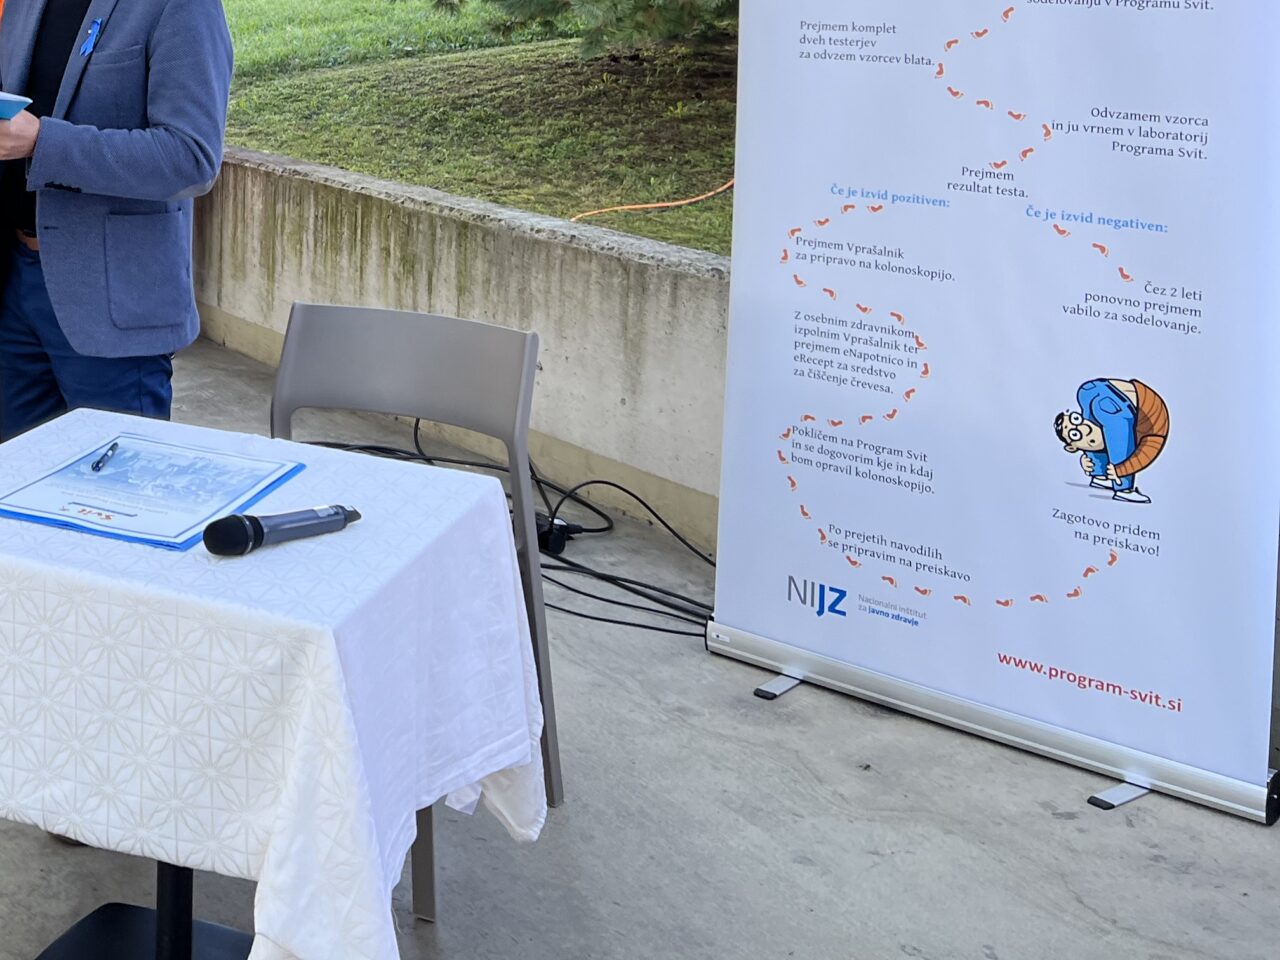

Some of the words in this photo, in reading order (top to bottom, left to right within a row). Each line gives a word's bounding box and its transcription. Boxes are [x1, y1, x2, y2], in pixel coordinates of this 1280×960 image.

[800, 21, 848, 33] Prejmem
[852, 22, 896, 35] komplet
[800, 35, 825, 45] dveh
[829, 37, 876, 49] testerjev
[799, 51, 810, 59] za
[814, 50, 855, 61] odvzem
[860, 55, 901, 63] vzorcev
[904, 54, 935, 65] blata.
[1091, 107, 1160, 123] Odvzamem
[1165, 115, 1208, 126] vzorca
[1052, 120, 1063, 130] in
[1066, 122, 1079, 134] ju
[1083, 124, 1123, 135] vrnem
[1128, 128, 1135, 136] v
[1139, 126, 1208, 145] laboratorij
[1112, 141, 1174, 157] Programa
[1178, 148, 1207, 159] Svit.
[961, 167, 1014, 181] Prejmem
[830, 183, 844, 195] Če
[846, 187, 858, 198] je
[861, 188, 888, 200] izvid
[891, 193, 950, 208] pozitiven:
[947, 181, 992, 194] rezultat
[996, 186, 1028, 198] testa.
[1026, 205, 1041, 217] Če
[1043, 209, 1056, 221] je
[1061, 211, 1093, 223] izvid
[1097, 216, 1168, 233] negativen:
[796, 237, 844, 250] Prejmem
[847, 242, 904, 259] Vprašalnik
[795, 252, 807, 260] za
[810, 254, 856, 268] pripravo
[859, 260, 871, 269] na
[875, 261, 955, 282] kolonoskopijo.
[1144, 280, 1167, 295] Čez
[1170, 287, 1177, 296] 2
[1182, 287, 1202, 301] leti
[1085, 292, 1140, 308] ponovno
[1144, 300, 1202, 317] prejmem
[795, 311, 801, 319] Z
[804, 313, 848, 327] osebnim
[1063, 303, 1100, 317] vabilo
[1104, 311, 1118, 320] za
[1122, 313, 1201, 335] sodelovanje.
[794, 324, 840, 340] izpolnim
[843, 333, 900, 350] Vprašalnik
[903, 344, 919, 354] ter
[794, 341, 840, 354] prejmem
[843, 348, 904, 366] eNapotnico
[907, 358, 918, 368] in
[794, 354, 834, 369] eRecept
[837, 362, 848, 370] za
[851, 364, 896, 379] sredstvo
[794, 368, 804, 376] za
[808, 368, 848, 386] čiščenje
[850, 376, 893, 394] črevesa.
[792, 426, 838, 443] Pokličem
[841, 438, 853, 447] na
[856, 440, 903, 457] Program
[907, 450, 928, 462] Svit
[792, 440, 801, 449] in
[804, 444, 814, 452] se
[817, 445, 873, 465] dogovorim
[877, 457, 893, 470] kje
[896, 462, 907, 472] in
[910, 464, 933, 480] kdaj
[791, 453, 813, 466] bom
[816, 460, 852, 476] opravil
[855, 467, 934, 494] kolonoskopijo.
[1052, 508, 1110, 529] Zagotovo
[1114, 523, 1160, 540] pridem
[828, 524, 841, 535] Po
[845, 529, 887, 546] prejetih
[890, 541, 942, 560] navodilih
[1075, 530, 1089, 540] na
[1093, 534, 1160, 557] preiskavo!
[828, 540, 839, 548] se
[842, 543, 896, 563] pripravim
[899, 558, 912, 567] na
[915, 560, 970, 582] preiskavo
[788, 575, 847, 617] NIJZ
[858, 594, 897, 611] Nacionalni
[868, 605, 889, 618] javno
[891, 613, 919, 627] zdravje
[998, 652, 1182, 712] www.program-svit.si
